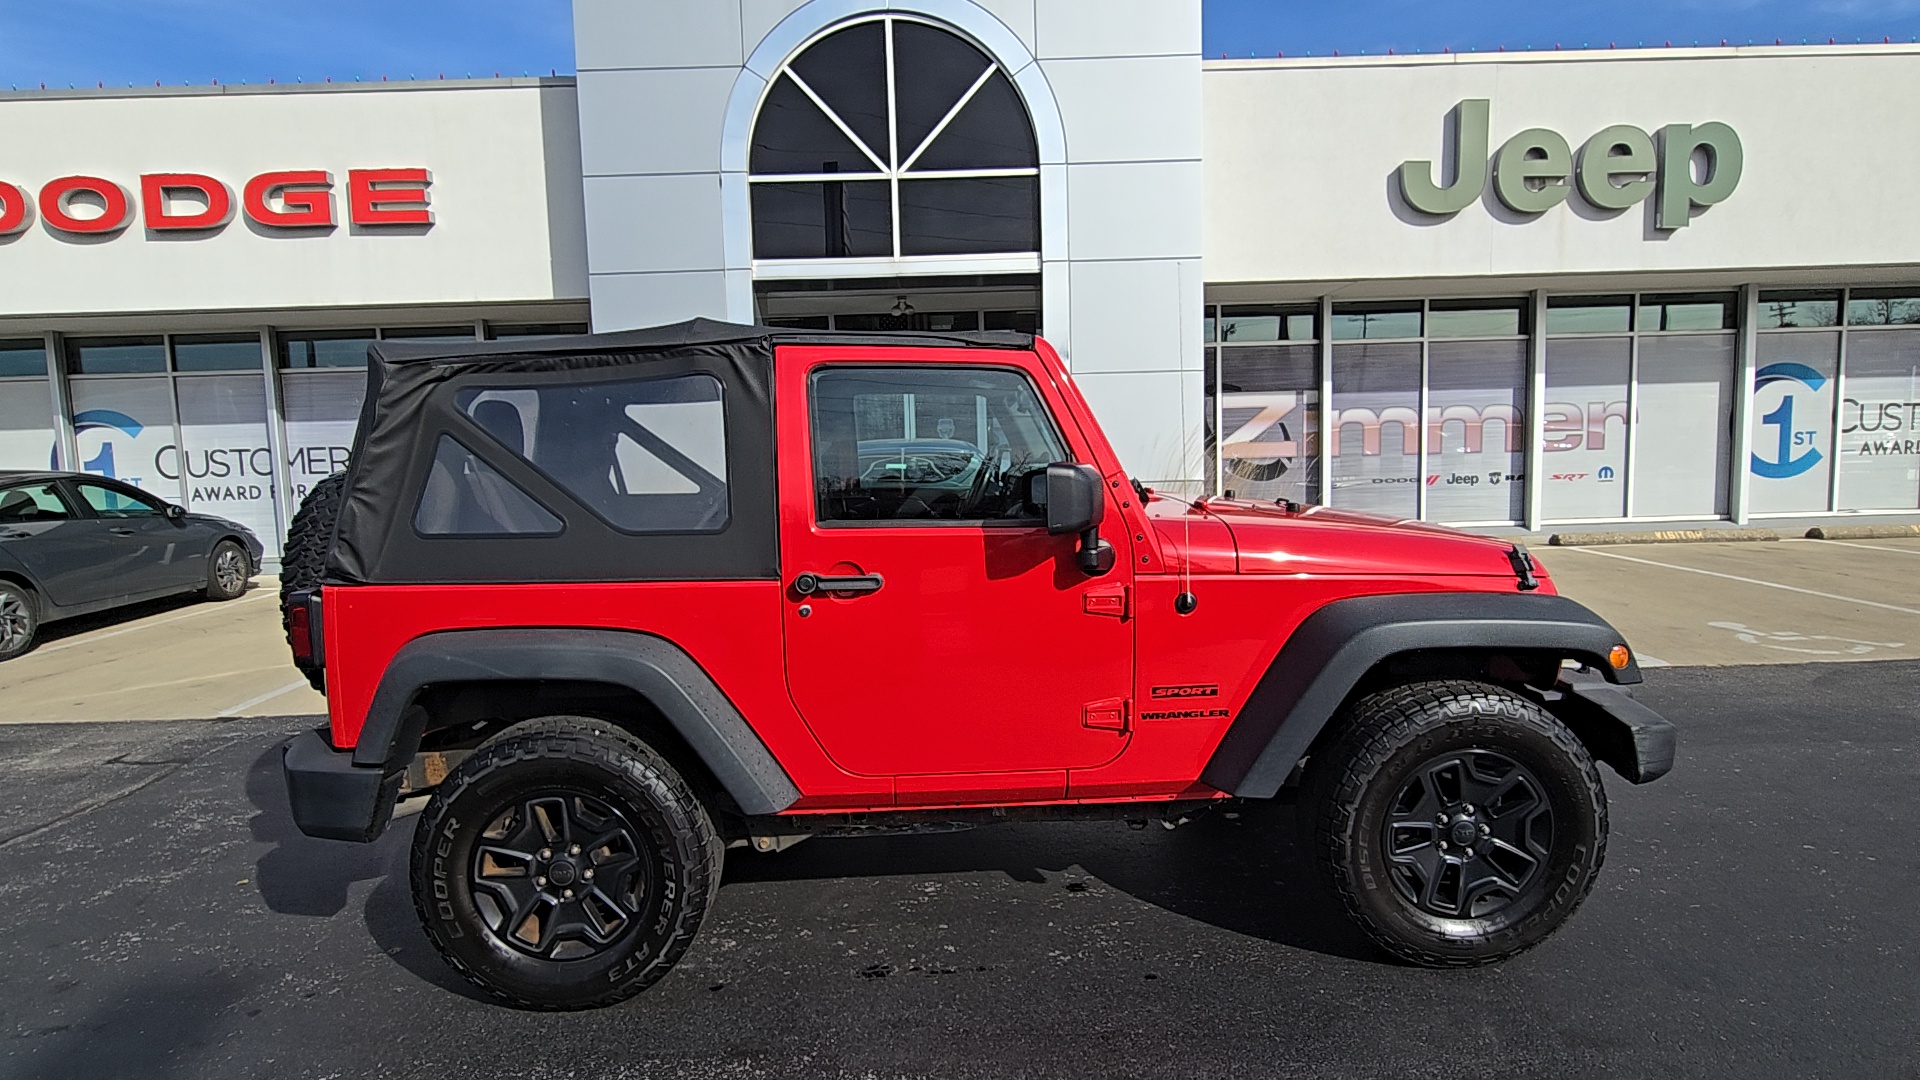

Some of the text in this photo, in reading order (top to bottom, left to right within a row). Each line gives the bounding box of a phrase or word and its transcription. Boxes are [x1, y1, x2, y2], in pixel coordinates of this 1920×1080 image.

[1402, 98, 1744, 229] Jeep
[0, 168, 434, 236] ODGE
[1220, 389, 1640, 459] Zimmer
[1859, 439, 1920, 456] AWAR
[1446, 473, 1479, 486] Jeep
[1549, 473, 1589, 481] SRT
[192, 485, 261, 502] AWARD
[1654, 530, 1704, 540] VISITOR
[1155, 687, 1213, 696] SPORT
[1140, 709, 1230, 720] WRANGLER
[433, 816, 464, 939] COOPER
[607, 940, 650, 983] AT3
